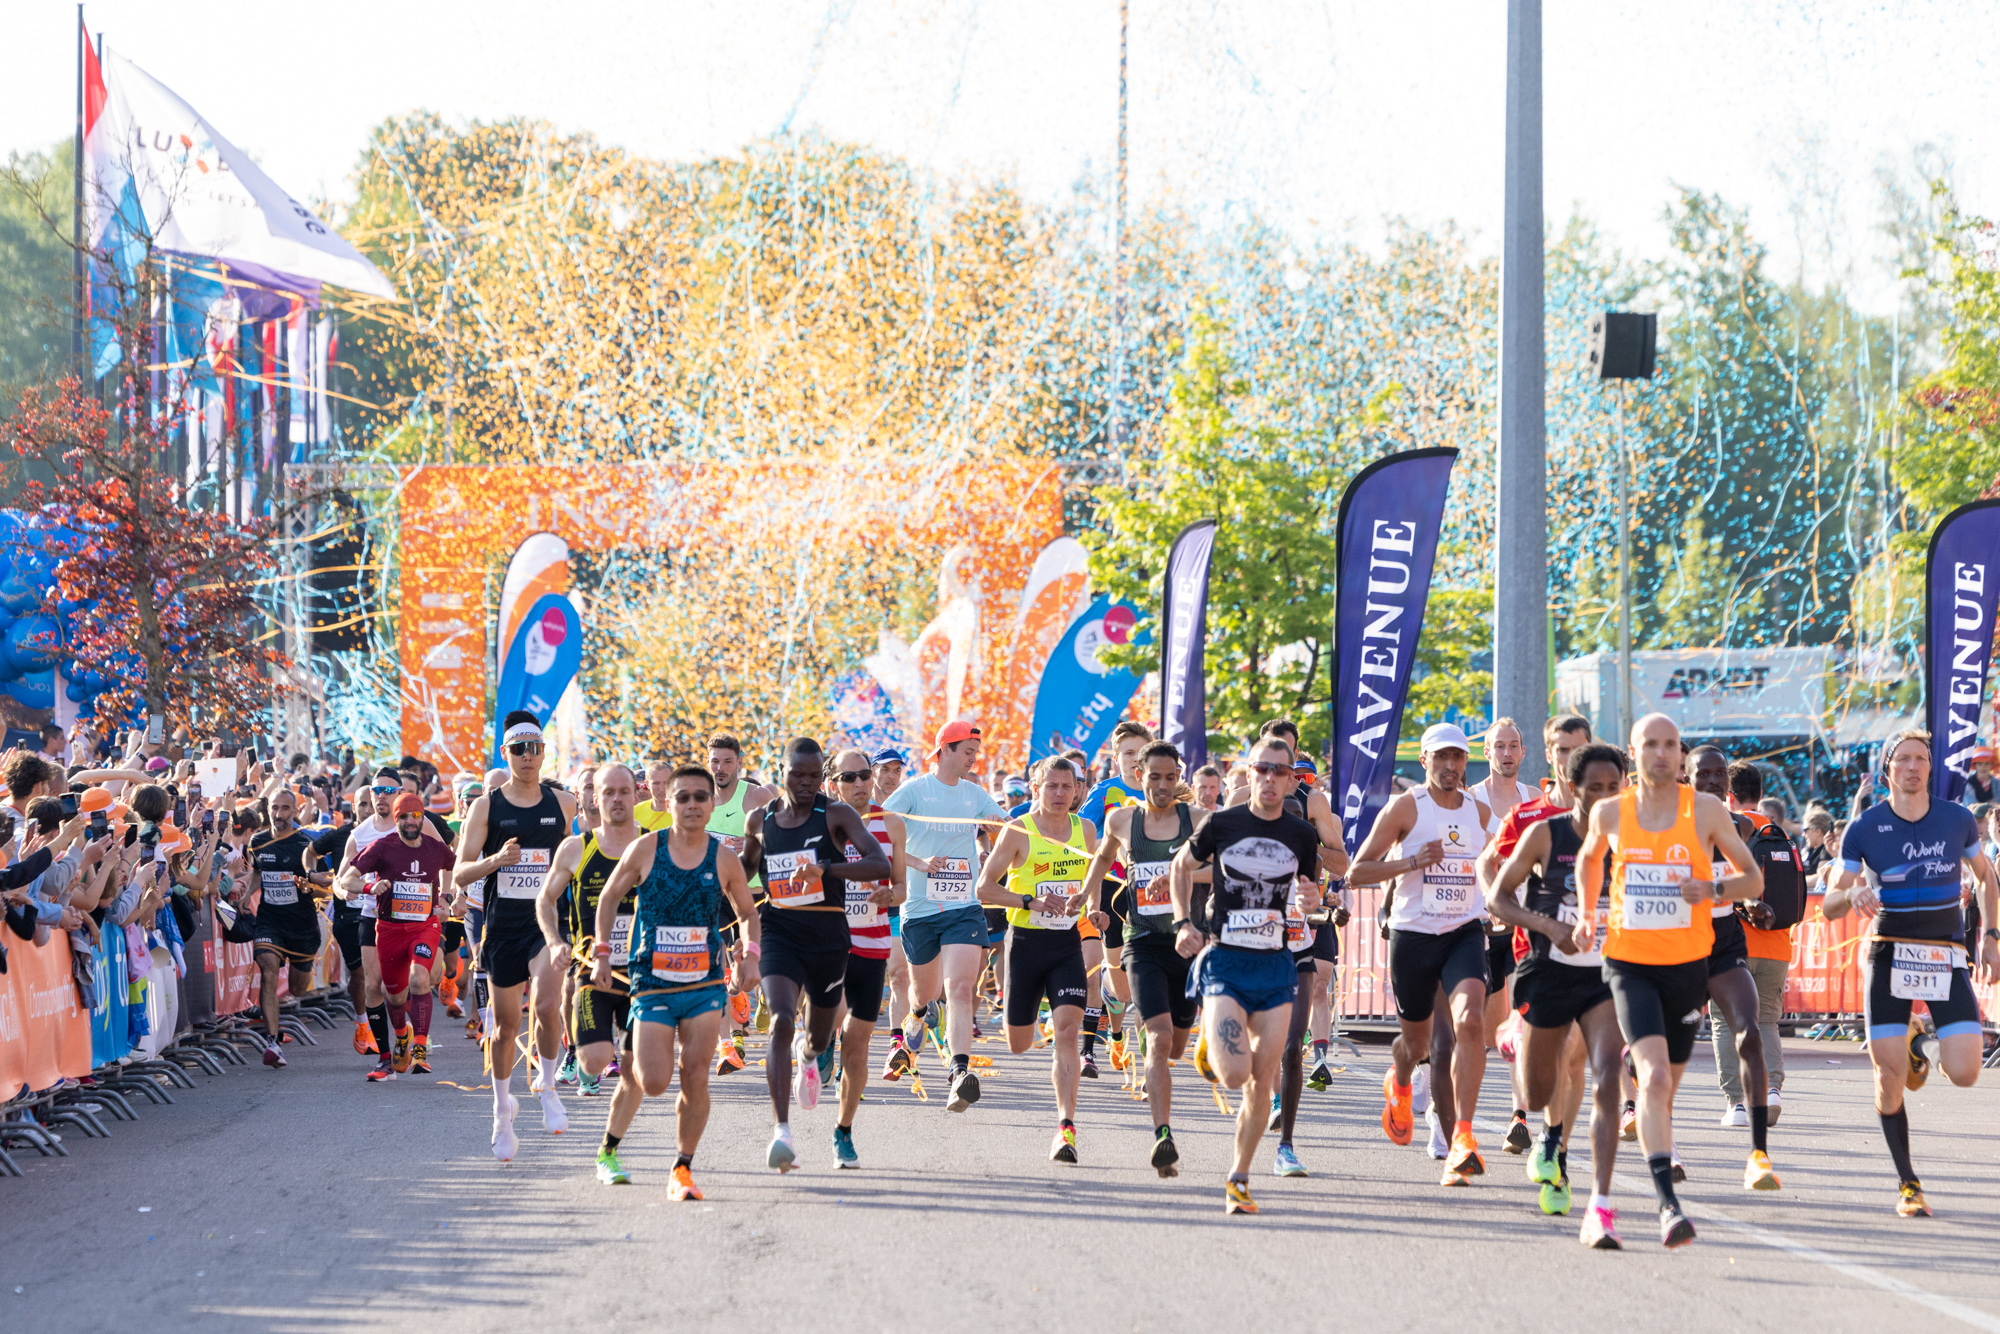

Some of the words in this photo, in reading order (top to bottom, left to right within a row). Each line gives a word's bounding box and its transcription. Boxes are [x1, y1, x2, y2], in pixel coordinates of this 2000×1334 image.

[1349, 519, 1417, 760] AVENUE
[1944, 562, 1985, 780] AVENUE
[1518, 809, 1541, 819] Kempa
[925, 822, 972, 833] VALENCIA
[1902, 841, 1946, 860] World
[770, 857, 792, 869] ING
[1053, 859, 1086, 868] runners
[1429, 862, 1458, 874] ING
[1924, 860, 1956, 876] Floor
[263, 873, 279, 881] ING
[1053, 868, 1068, 876] lab
[1138, 866, 1165, 878] ING
[1629, 869, 1661, 883] ING
[509, 876, 541, 888] 7206
[934, 881, 967, 892] 13752
[1427, 877, 1473, 885] LUXEMBOURG
[267, 889, 292, 898] 11806
[396, 884, 416, 894] ING
[778, 881, 804, 896] 130
[1040, 885, 1064, 895] ING
[1627, 886, 1681, 897] LUXEMBOUR
[1435, 888, 1467, 902] 8890
[400, 902, 424, 912] 2876
[845, 903, 868, 916] 200
[1635, 901, 1677, 916] 8700
[1233, 914, 1262, 925] ING
[659, 931, 687, 943] ING
[657, 945, 706, 953] LUXEMBOURG
[1898, 947, 1927, 961] ING
[665, 956, 699, 970] 2675
[1896, 961, 1948, 971] LUXEMBOURG
[1903, 974, 1938, 988] 9311
